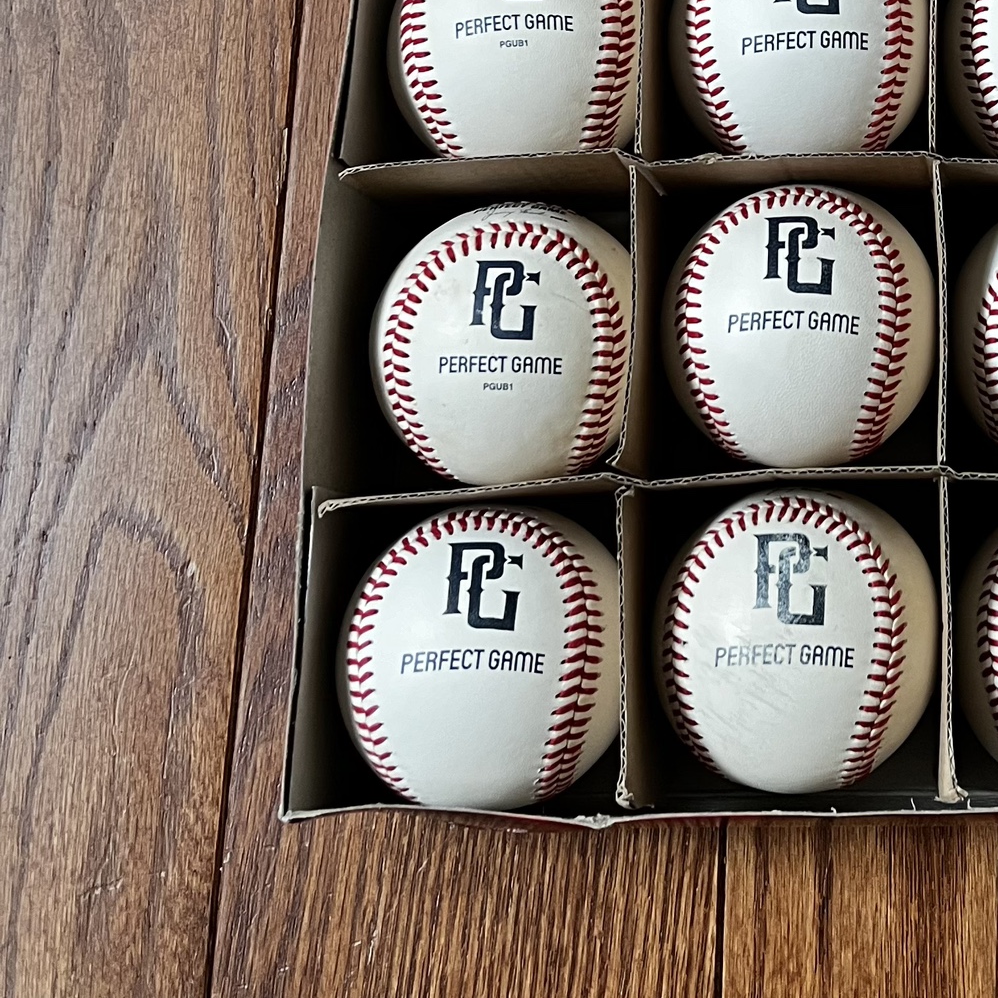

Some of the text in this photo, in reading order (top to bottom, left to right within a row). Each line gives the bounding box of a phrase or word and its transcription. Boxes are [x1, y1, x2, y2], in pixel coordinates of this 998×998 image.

[455, 13, 575, 40] PERFECT GAME
[499, 39, 529, 48] PGUB1
[741, 30, 869, 56] PERFECT GAME
[727, 310, 860, 335] PERFECT GAME
[438, 355, 563, 375] PERFECT GAME
[483, 382, 514, 391] PGUB1
[400, 648, 546, 675] PERFECT GAME
[714, 643, 855, 669] PERFECT GAME
